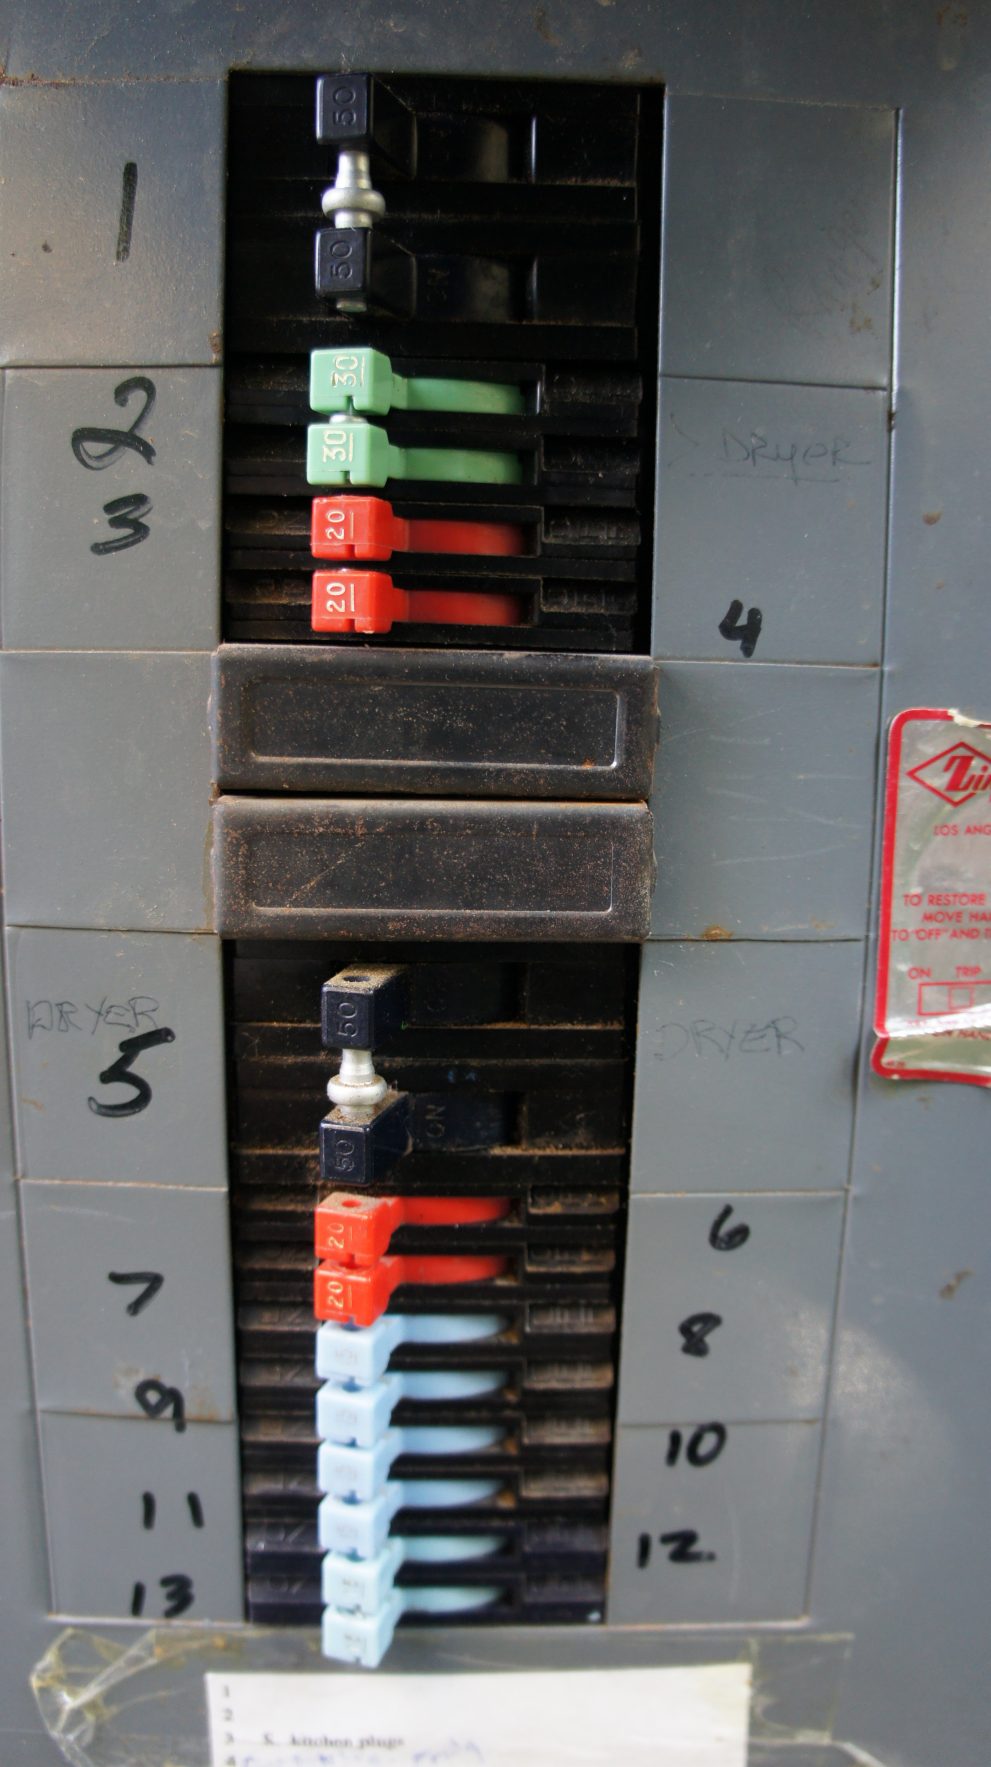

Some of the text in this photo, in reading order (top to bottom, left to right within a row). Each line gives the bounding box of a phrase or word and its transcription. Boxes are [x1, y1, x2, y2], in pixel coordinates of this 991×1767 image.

[332, 86, 357, 126] 50
[115, 161, 139, 263] 1
[329, 239, 354, 280] 50
[330, 354, 360, 388] 30
[71, 375, 157, 472] 2
[322, 429, 348, 464] 30
[89, 493, 154, 556] 3
[325, 509, 346, 541] 20
[325, 581, 346, 614] 20
[718, 599, 763, 658] 4
[933, 823, 960, 837] LOS
[902, 892, 988, 907] TO RESTORE
[921, 911, 964, 924] MOVE
[892, 928, 910, 942] TO
[950, 927, 981, 940] AND
[907, 964, 983, 980] ON TRIP
[26, 995, 161, 1040] DRYER
[336, 1001, 359, 1038] 50
[652, 1015, 806, 1062] DRYER
[88, 1026, 176, 1118] 5
[334, 1138, 356, 1172] 50
[326, 1221, 346, 1250] 20
[708, 1204, 751, 1252] 6
[107, 1270, 165, 1317] 7
[325, 1280, 345, 1309] 20
[678, 1311, 723, 1358] 8
[134, 1379, 187, 1434] 9
[665, 1421, 728, 1468] 10
[141, 1490, 205, 1531] 11
[130, 1573, 195, 1618] 13
[289, 1733, 354, 1750] kitchen
[358, 1733, 406, 1751] plugs
